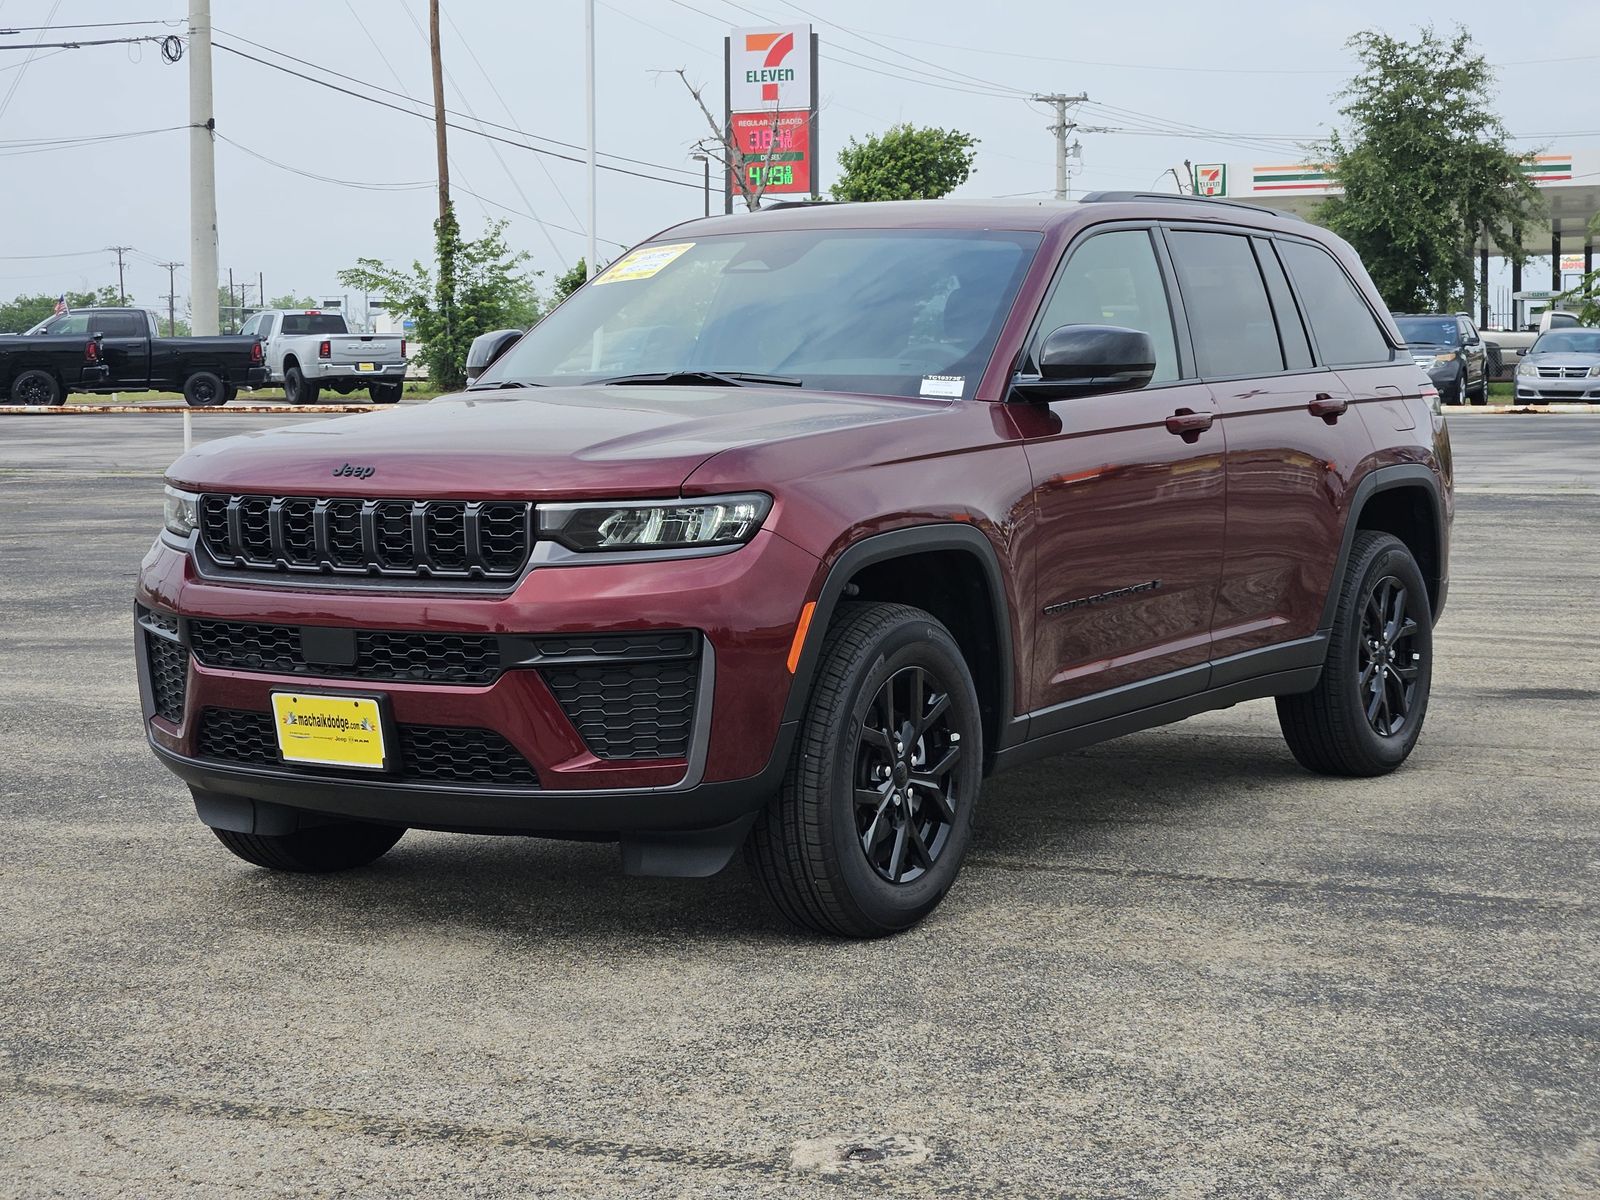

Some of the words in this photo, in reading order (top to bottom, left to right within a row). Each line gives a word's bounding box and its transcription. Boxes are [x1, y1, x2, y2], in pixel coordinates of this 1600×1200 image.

[738, 120, 768, 128] REGULAR
[769, 118, 803, 126] LEADED
[332, 463, 375, 480] Jeep
